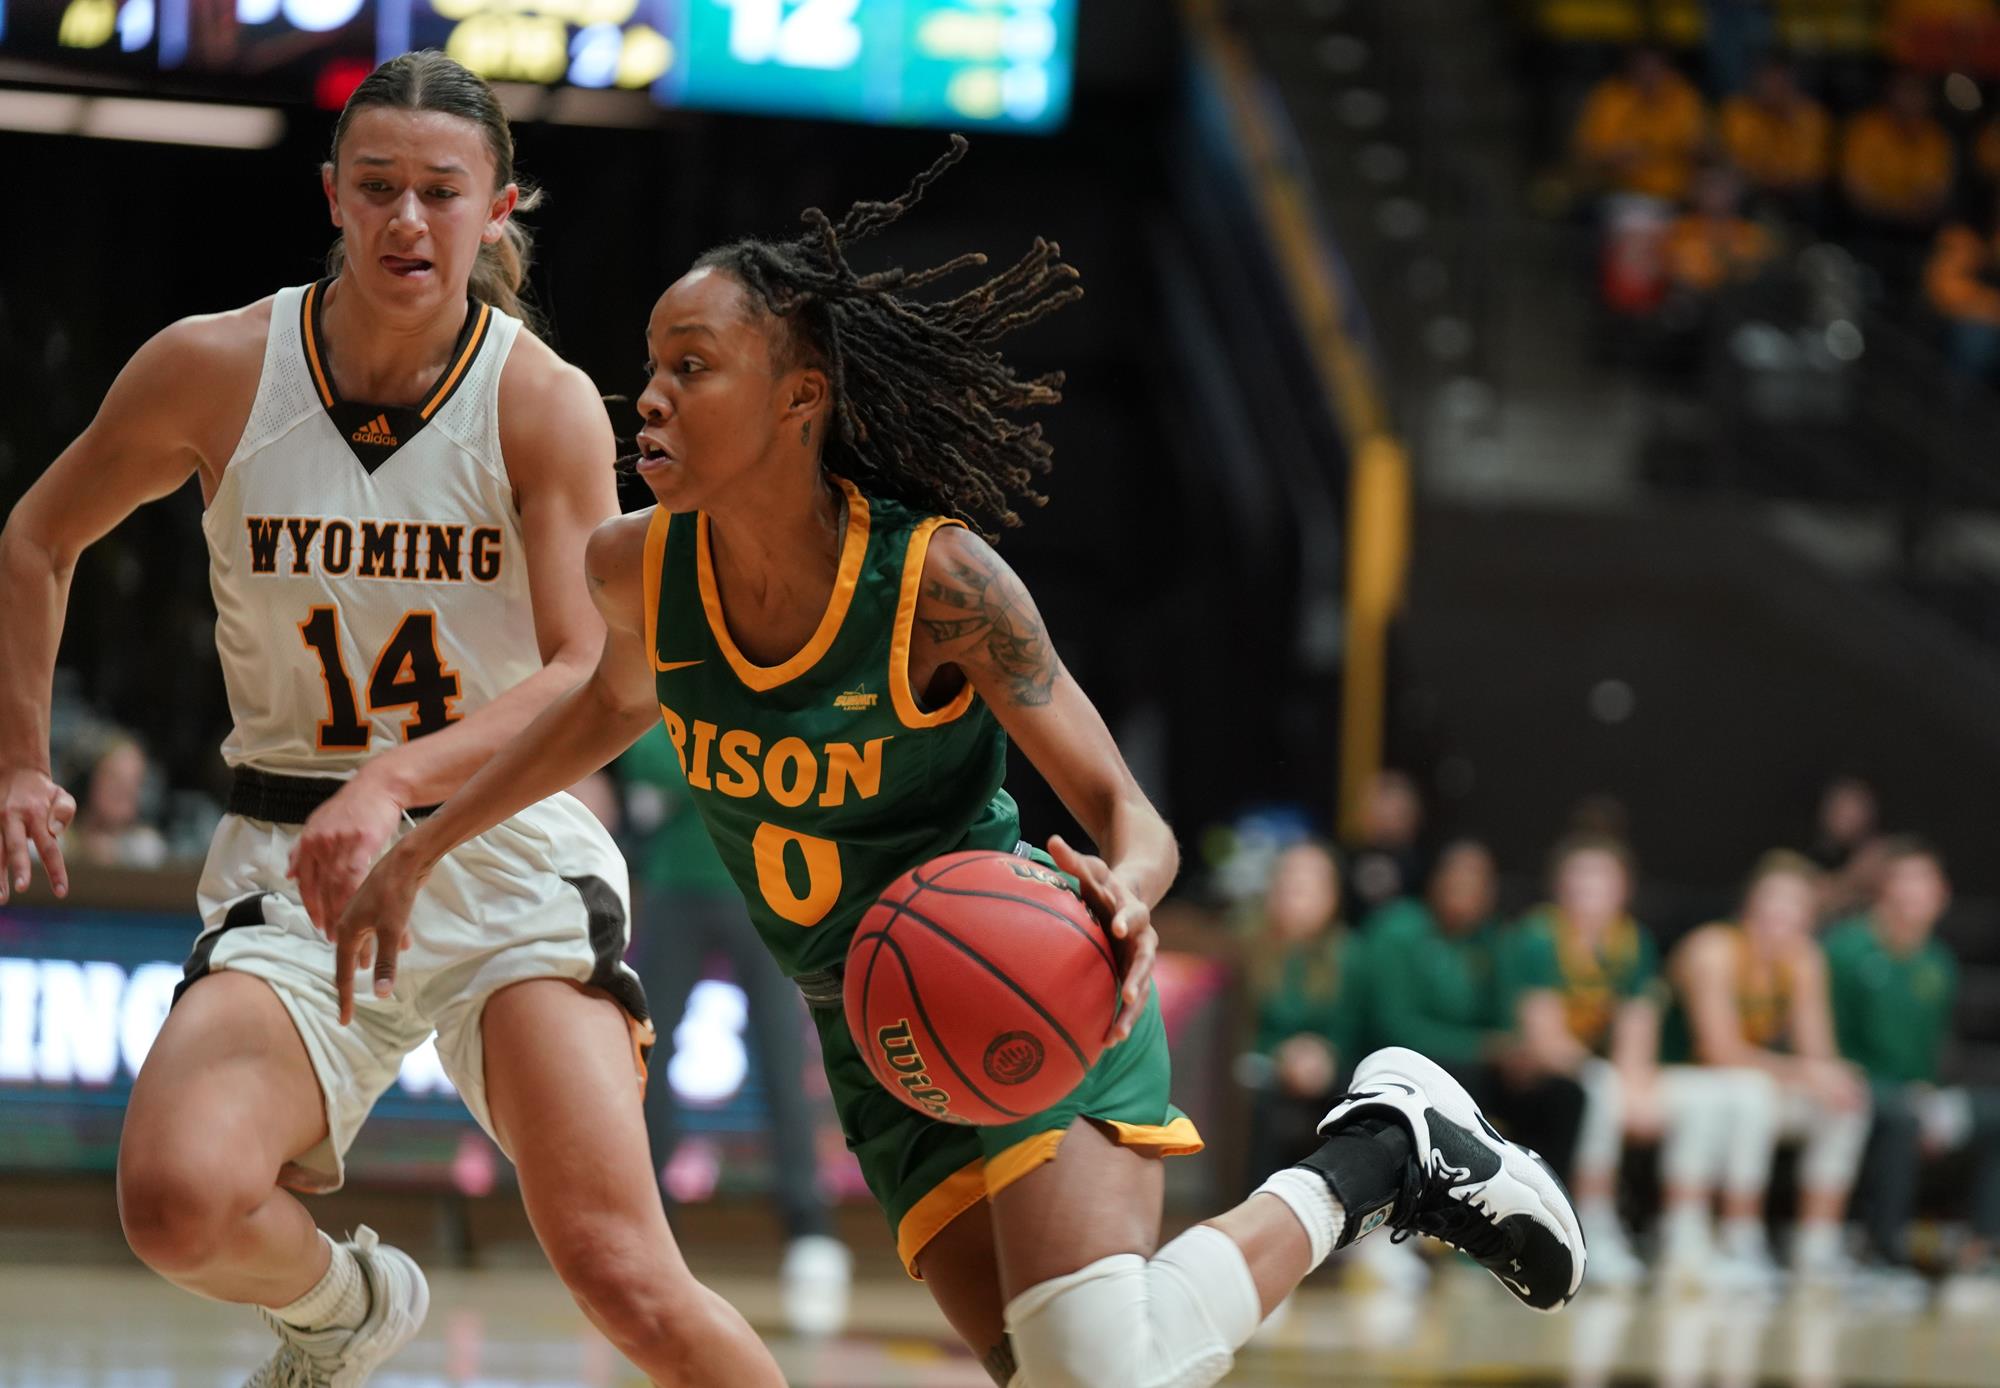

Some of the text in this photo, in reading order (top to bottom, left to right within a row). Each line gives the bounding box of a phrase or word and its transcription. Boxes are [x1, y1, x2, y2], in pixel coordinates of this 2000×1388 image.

[352, 431, 398, 446] adidas
[246, 515, 503, 583] WYOMING
[297, 603, 465, 752] 14
[752, 821, 843, 927] 0
